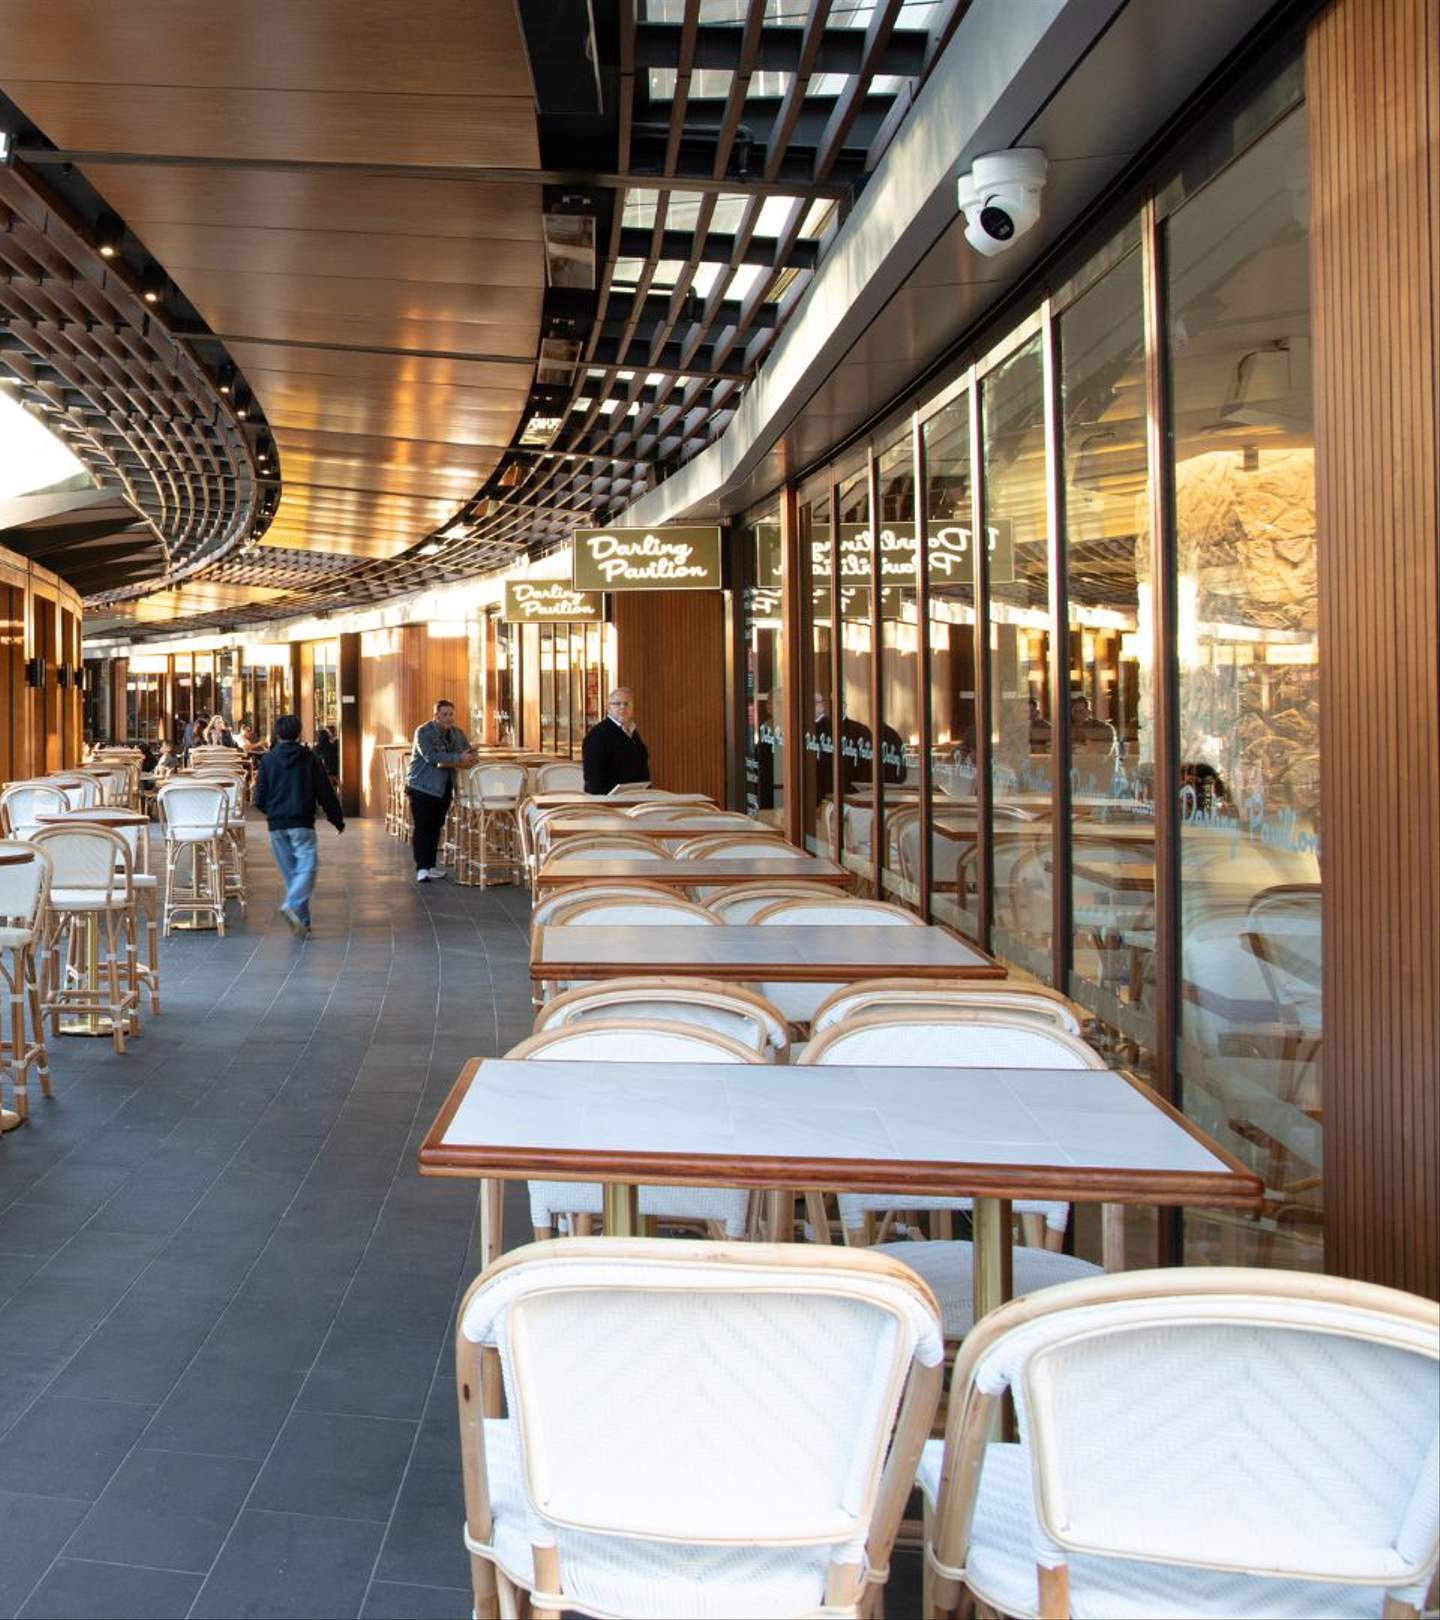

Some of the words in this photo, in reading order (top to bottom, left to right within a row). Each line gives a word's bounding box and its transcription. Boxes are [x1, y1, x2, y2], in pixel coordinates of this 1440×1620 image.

[587, 534, 693, 565] Darling
[598, 557, 708, 582] Pavilion
[512, 584, 586, 605] Darling
[520, 600, 595, 617] Pavilion
